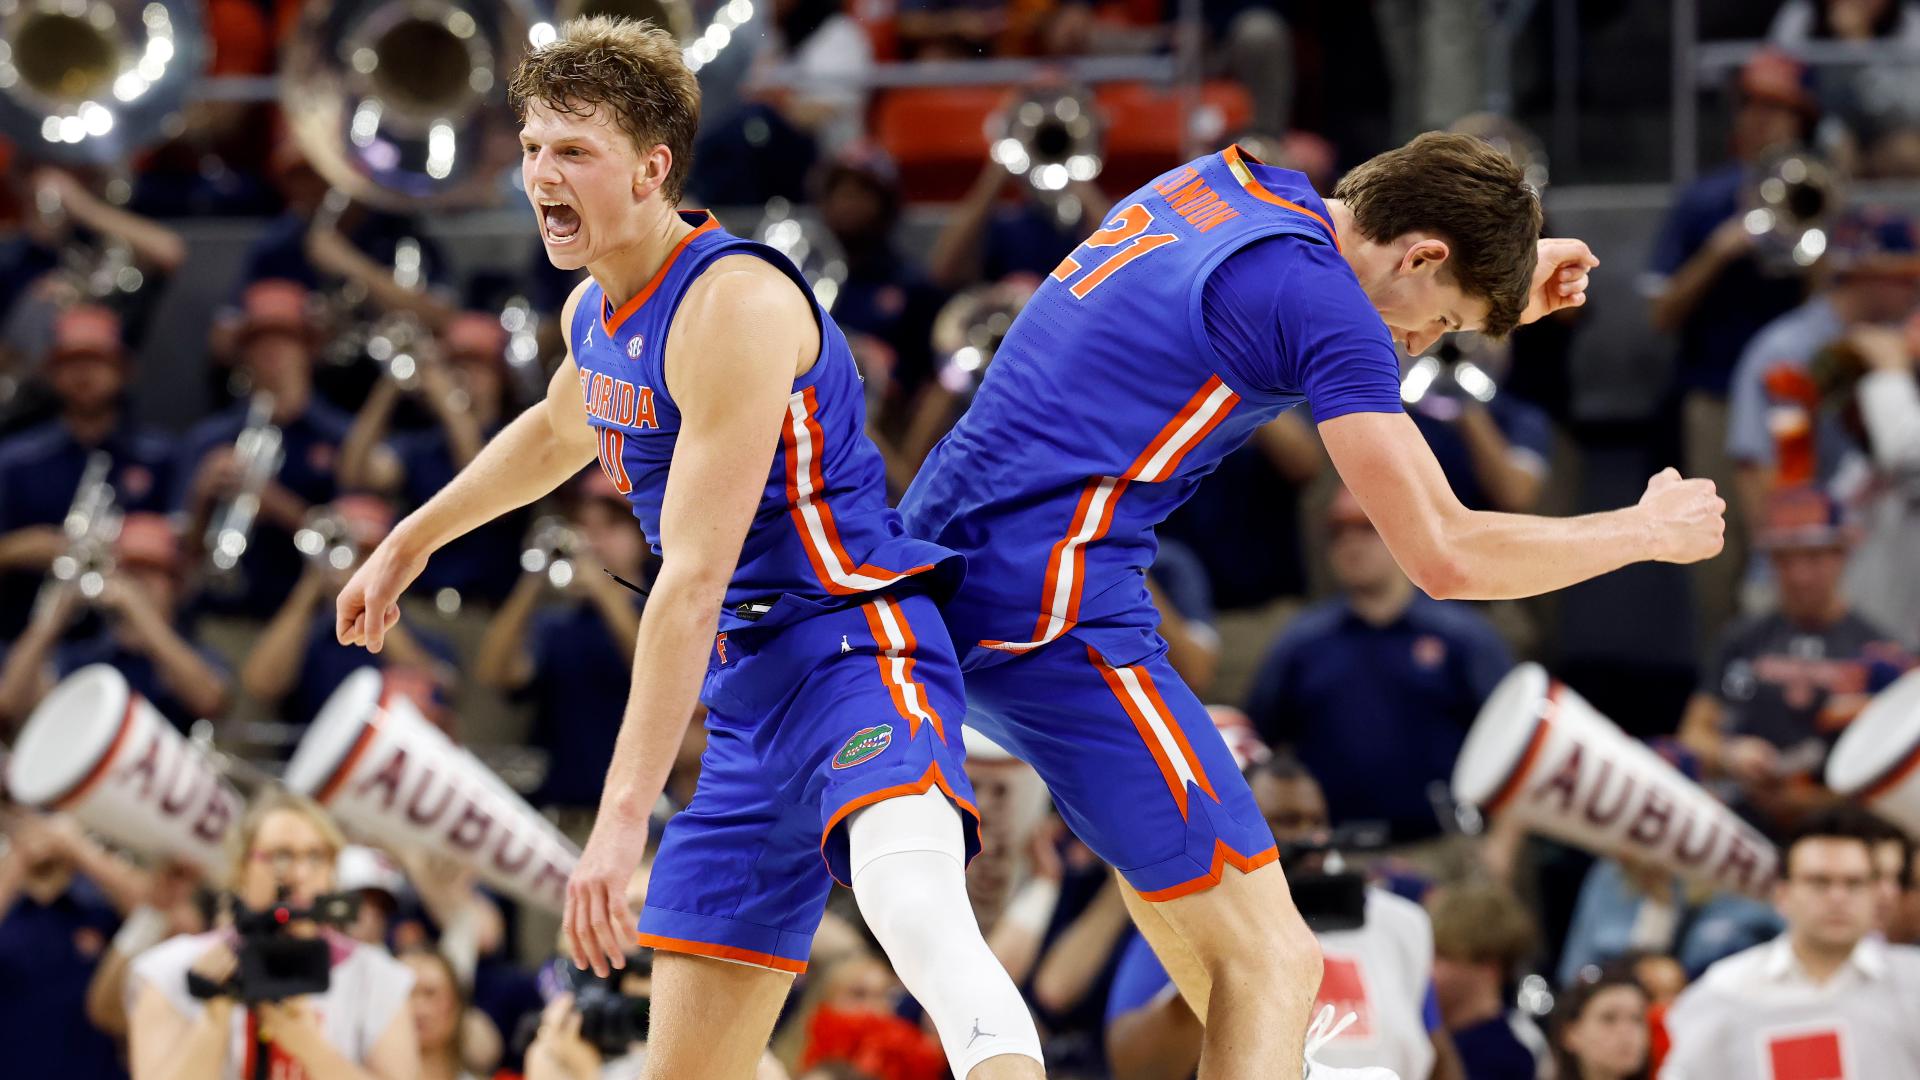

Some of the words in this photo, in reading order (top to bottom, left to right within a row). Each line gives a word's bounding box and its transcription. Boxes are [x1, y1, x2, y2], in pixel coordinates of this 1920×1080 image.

[1049, 203, 1180, 301] 21
[627, 336, 643, 358] SEC
[118, 734, 232, 844] AUB
[355, 744, 570, 902] AUBUR
[1532, 740, 1777, 900] AUBUR
